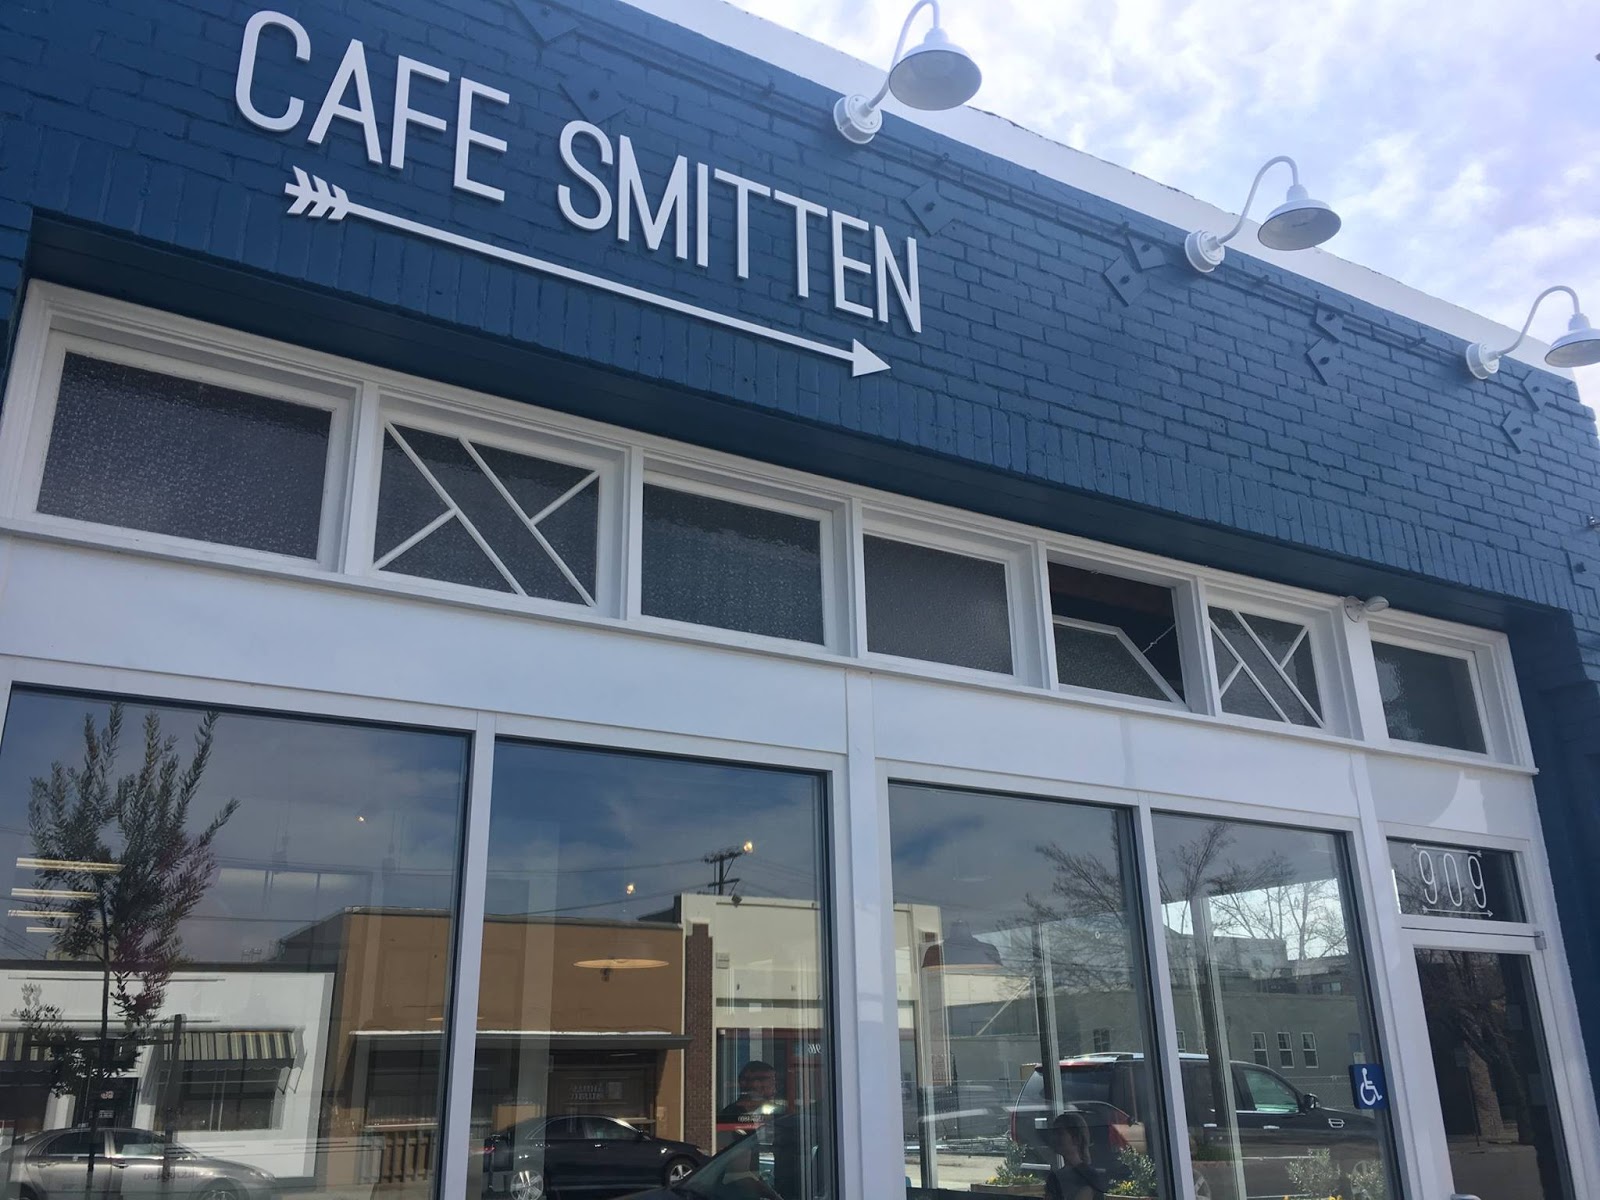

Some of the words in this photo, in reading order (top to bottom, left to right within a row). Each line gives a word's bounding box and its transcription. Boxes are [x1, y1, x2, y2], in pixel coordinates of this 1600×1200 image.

[235, 10, 510, 202] CAFE
[557, 119, 922, 334] SMITTEN
[1418, 850, 1487, 909] 909
